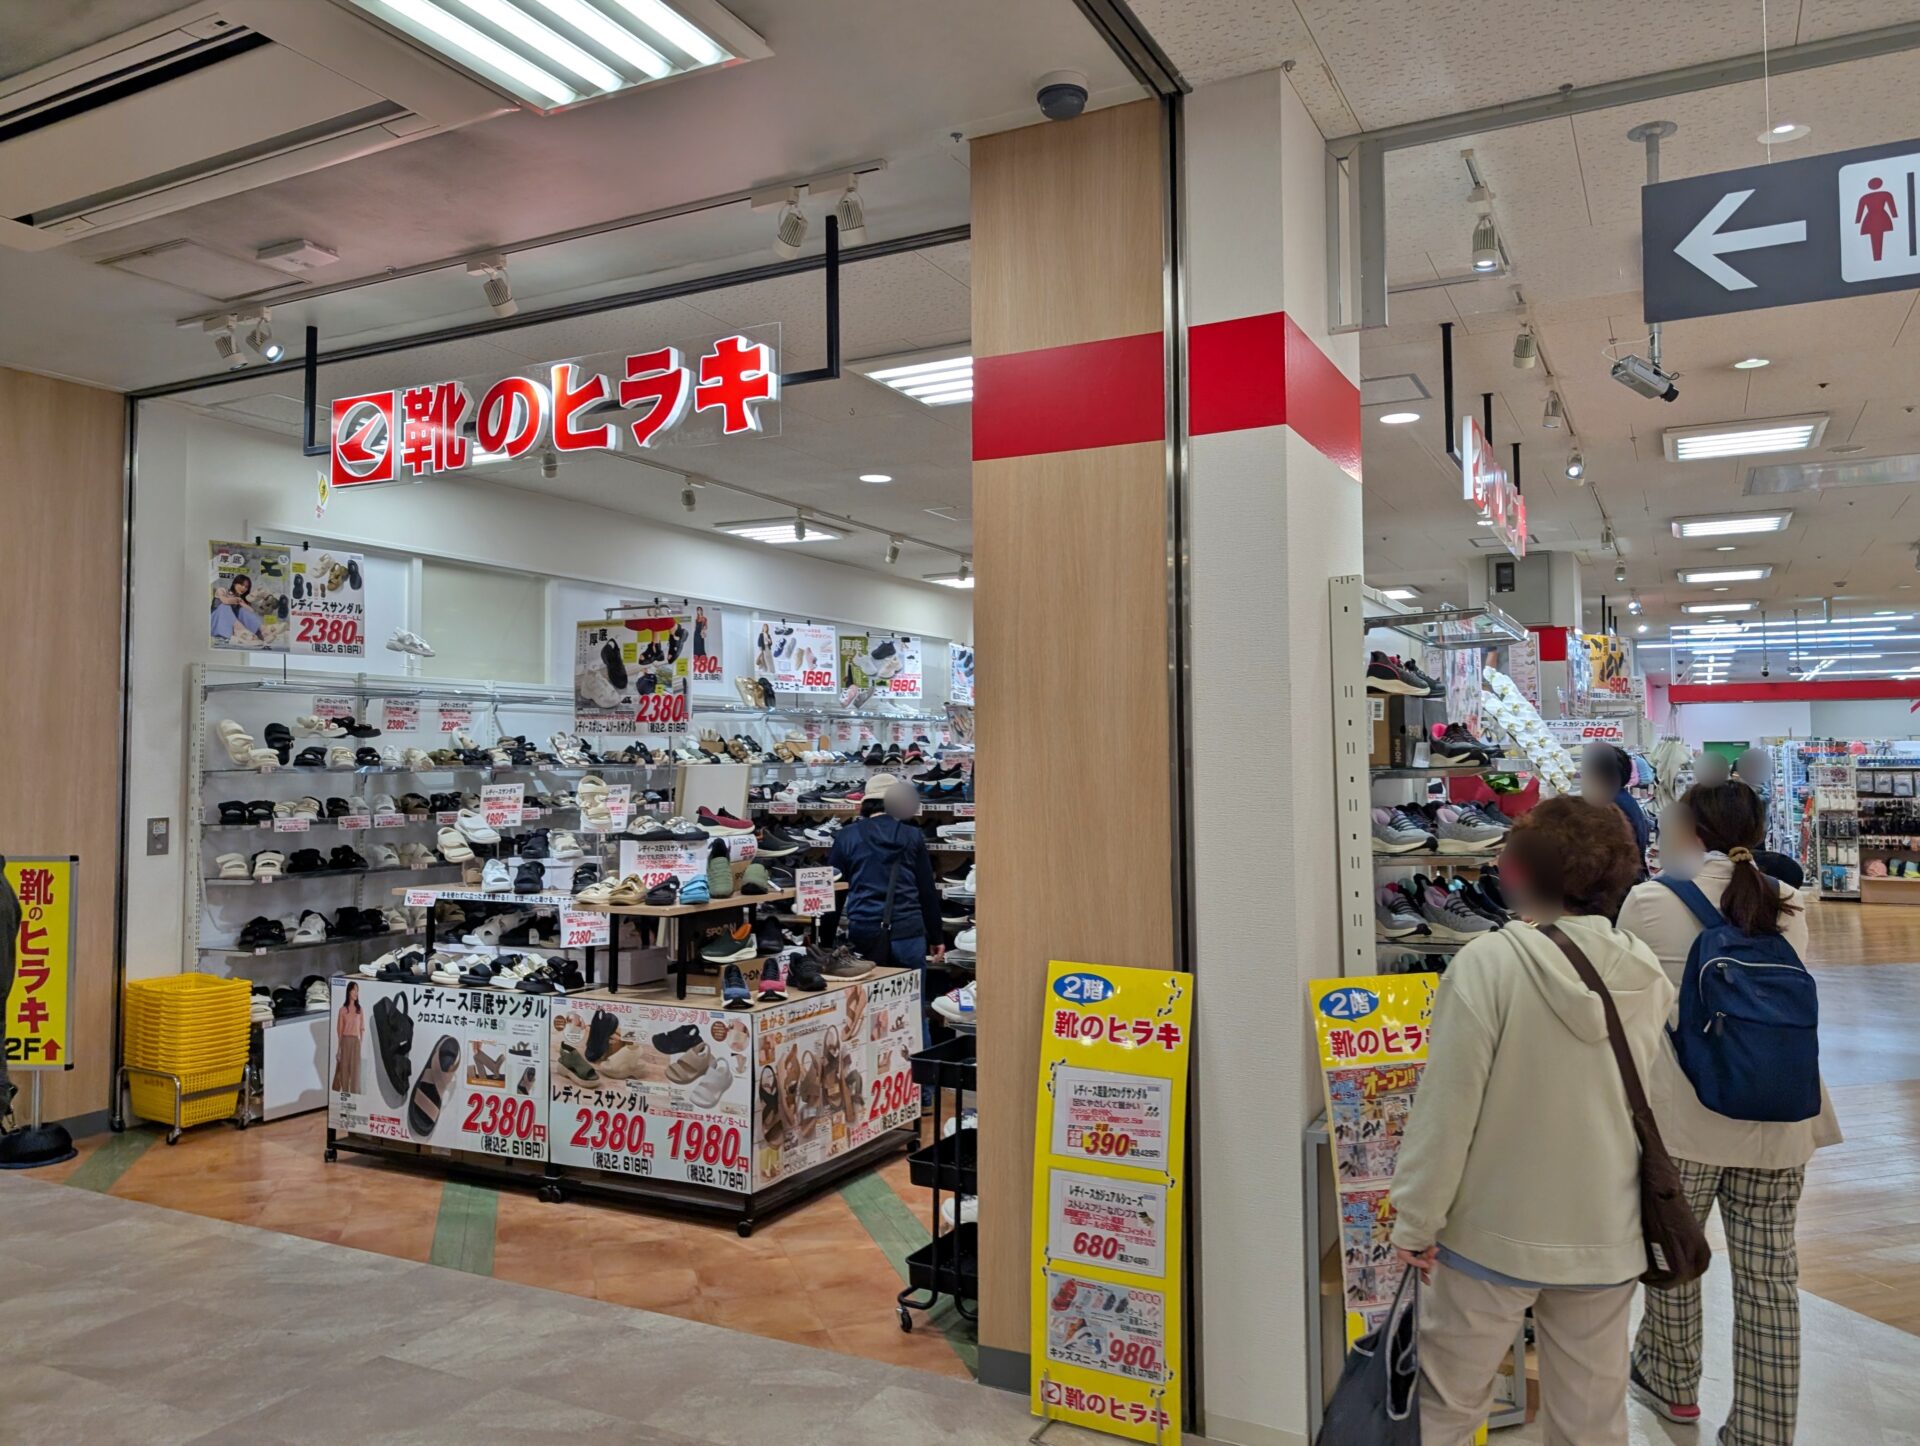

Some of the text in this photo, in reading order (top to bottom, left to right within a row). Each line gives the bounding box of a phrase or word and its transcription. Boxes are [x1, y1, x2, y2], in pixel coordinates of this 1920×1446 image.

[402, 335, 773, 475] 靴のヒラキ
[291, 600, 362, 614] レディースサンダル
[296, 617, 364, 645] 2380円
[802, 670, 835, 687] 1680円
[889, 679, 920, 693] 1980円
[636, 694, 689, 723] 2380円
[1582, 727, 1623, 737] 680円
[17, 868, 55, 1034] 靴のヒラキ
[867, 974, 920, 1003] レディースサンダル
[1063, 976, 1104, 1000] 2階
[412, 988, 548, 1019] レディース厚底サンダル
[638, 1006, 711, 1025] ニットサンダル
[1329, 990, 1371, 1016] 2階
[417, 1011, 498, 1031] クロスゴムでホールド感
[1054, 1010, 1181, 1050] 靴のヒラキ
[5, 1037, 41, 1061] 2F
[552, 1085, 650, 1114] レディースサンダル
[868, 1068, 920, 1121] 2380円
[462, 1092, 547, 1143] 2380円
[569, 1108, 655, 1159] 2380円
[667, 1119, 749, 1174] 1980円
[1084, 1131, 1138, 1157] 390円
[480, 1136, 545, 1160] (税込2,618円)
[592, 1151, 652, 1176] (税込2,618円)
[686, 1164, 747, 1191] (税込2,178円)
[1073, 1231, 1126, 1260] 680円
[1050, 1347, 1116, 1369] キッズスニーカー
[1108, 1338, 1162, 1372] 980円
[1064, 1385, 1170, 1432] 靴のヒラキ
